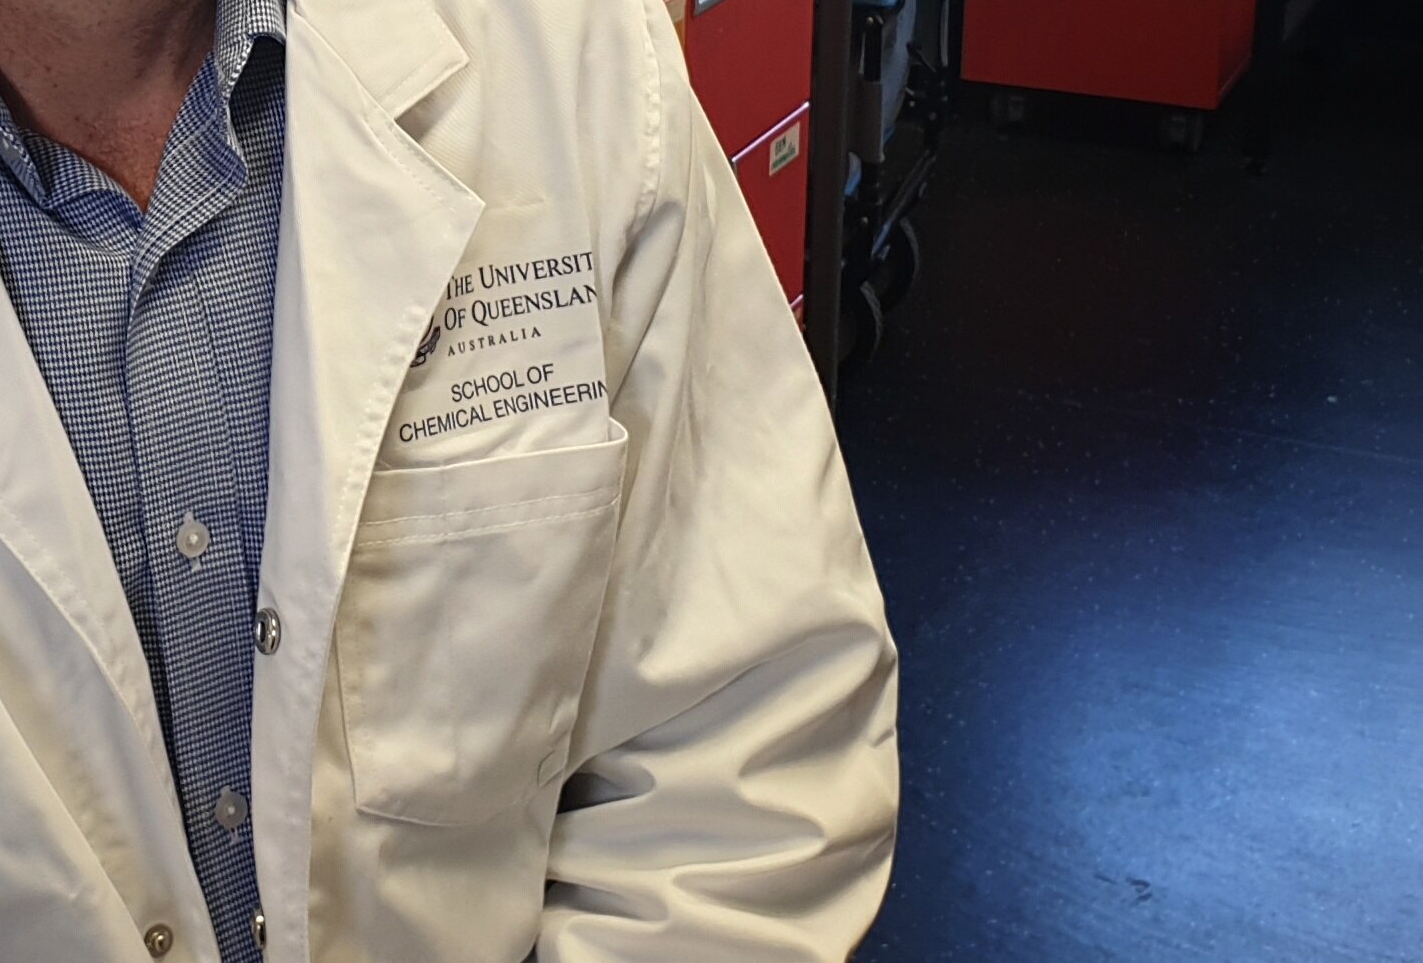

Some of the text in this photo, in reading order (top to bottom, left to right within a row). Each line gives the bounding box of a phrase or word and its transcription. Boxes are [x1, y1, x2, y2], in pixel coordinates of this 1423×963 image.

[445, 251, 593, 300] THE UNIVERSIT
[444, 307, 466, 330] OF
[447, 326, 542, 356] AUSTRALIA
[451, 363, 554, 403] SCHOOL OF
[399, 405, 492, 442] CHEMICAL
